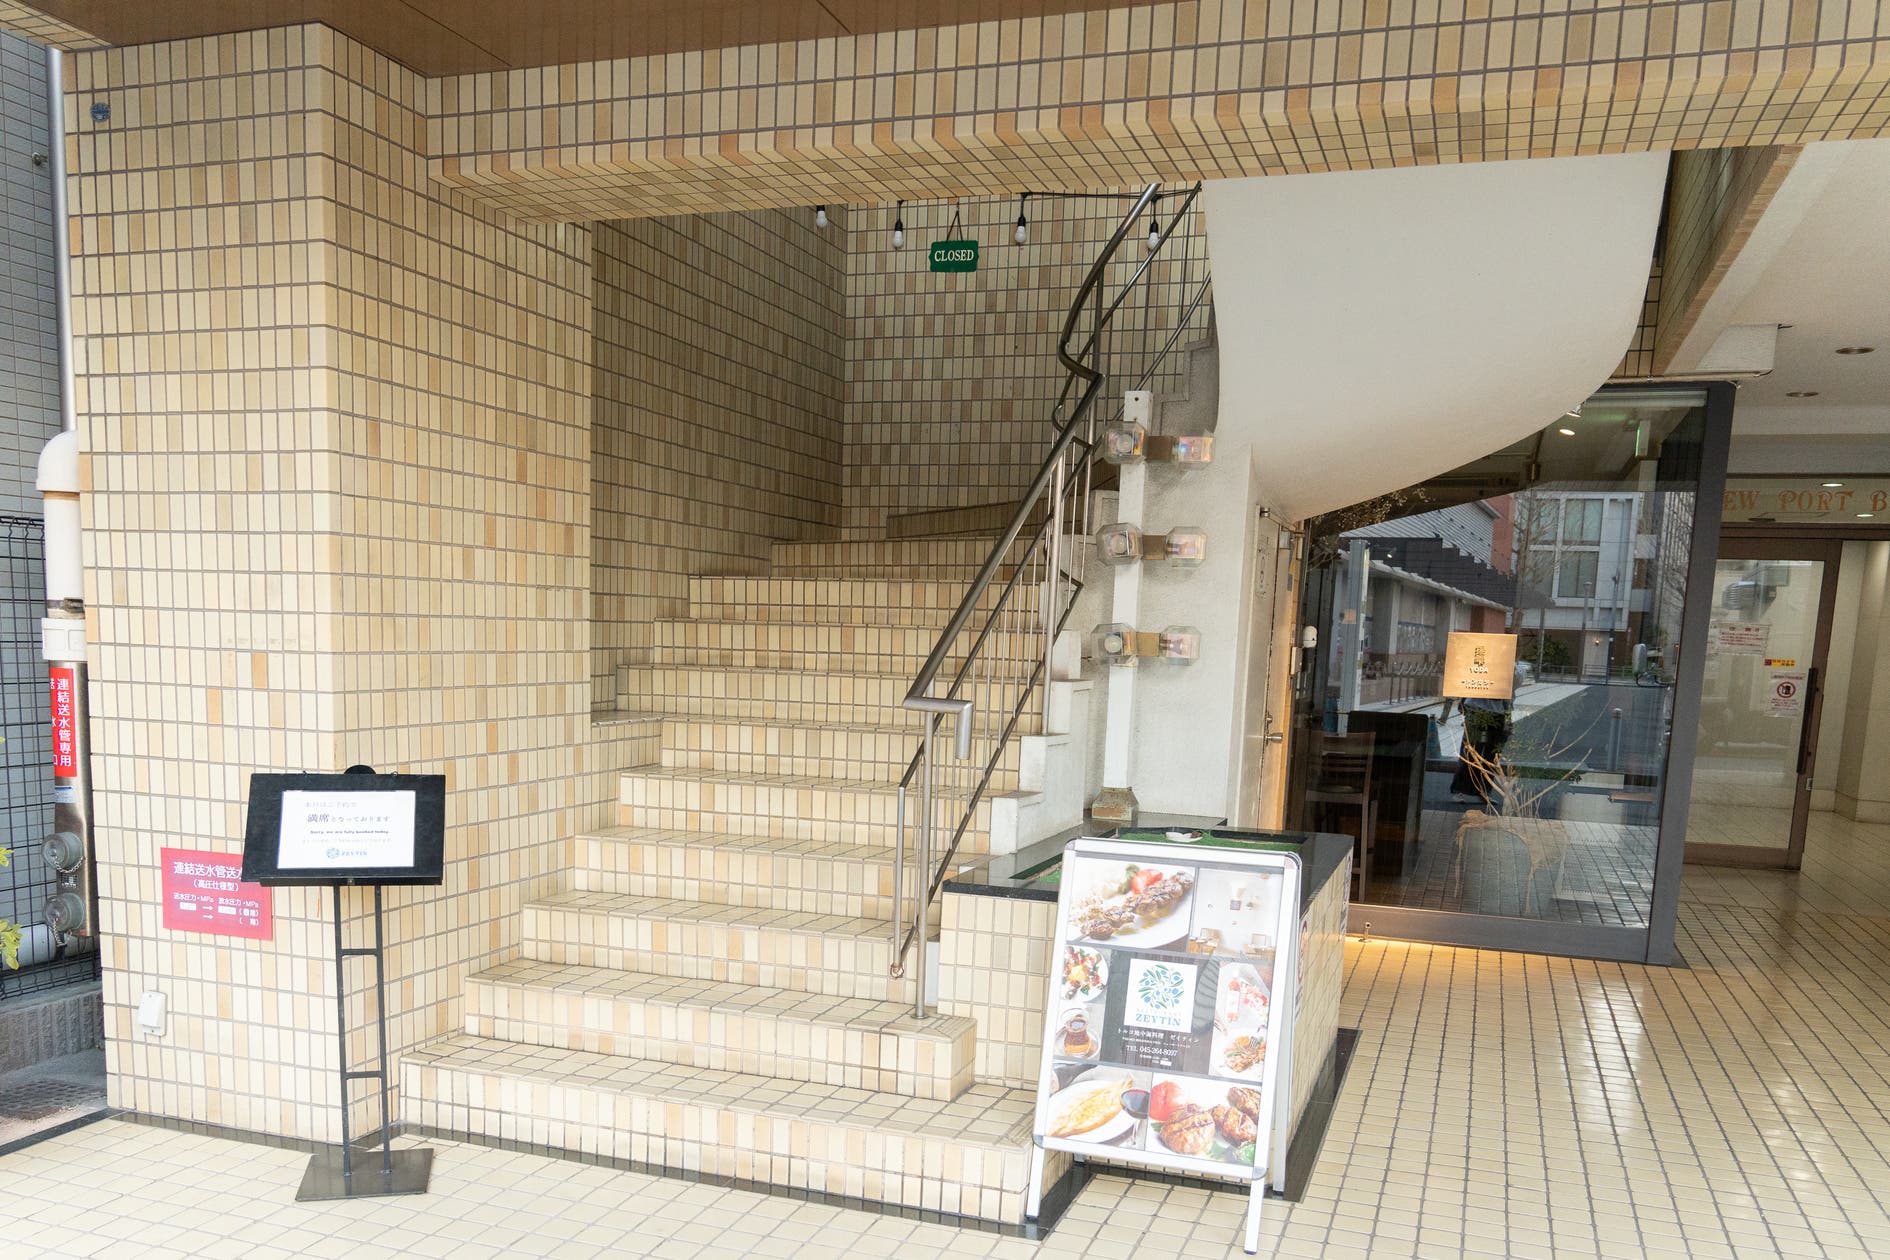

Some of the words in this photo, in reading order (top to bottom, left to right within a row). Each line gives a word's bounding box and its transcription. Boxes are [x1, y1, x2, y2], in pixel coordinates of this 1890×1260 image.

[934, 249, 974, 262] CLOSED
[1778, 489, 1855, 512] PORT
[56, 678, 72, 767] 連結送水管専用
[1136, 1013, 1181, 1026] ZEYTIN
